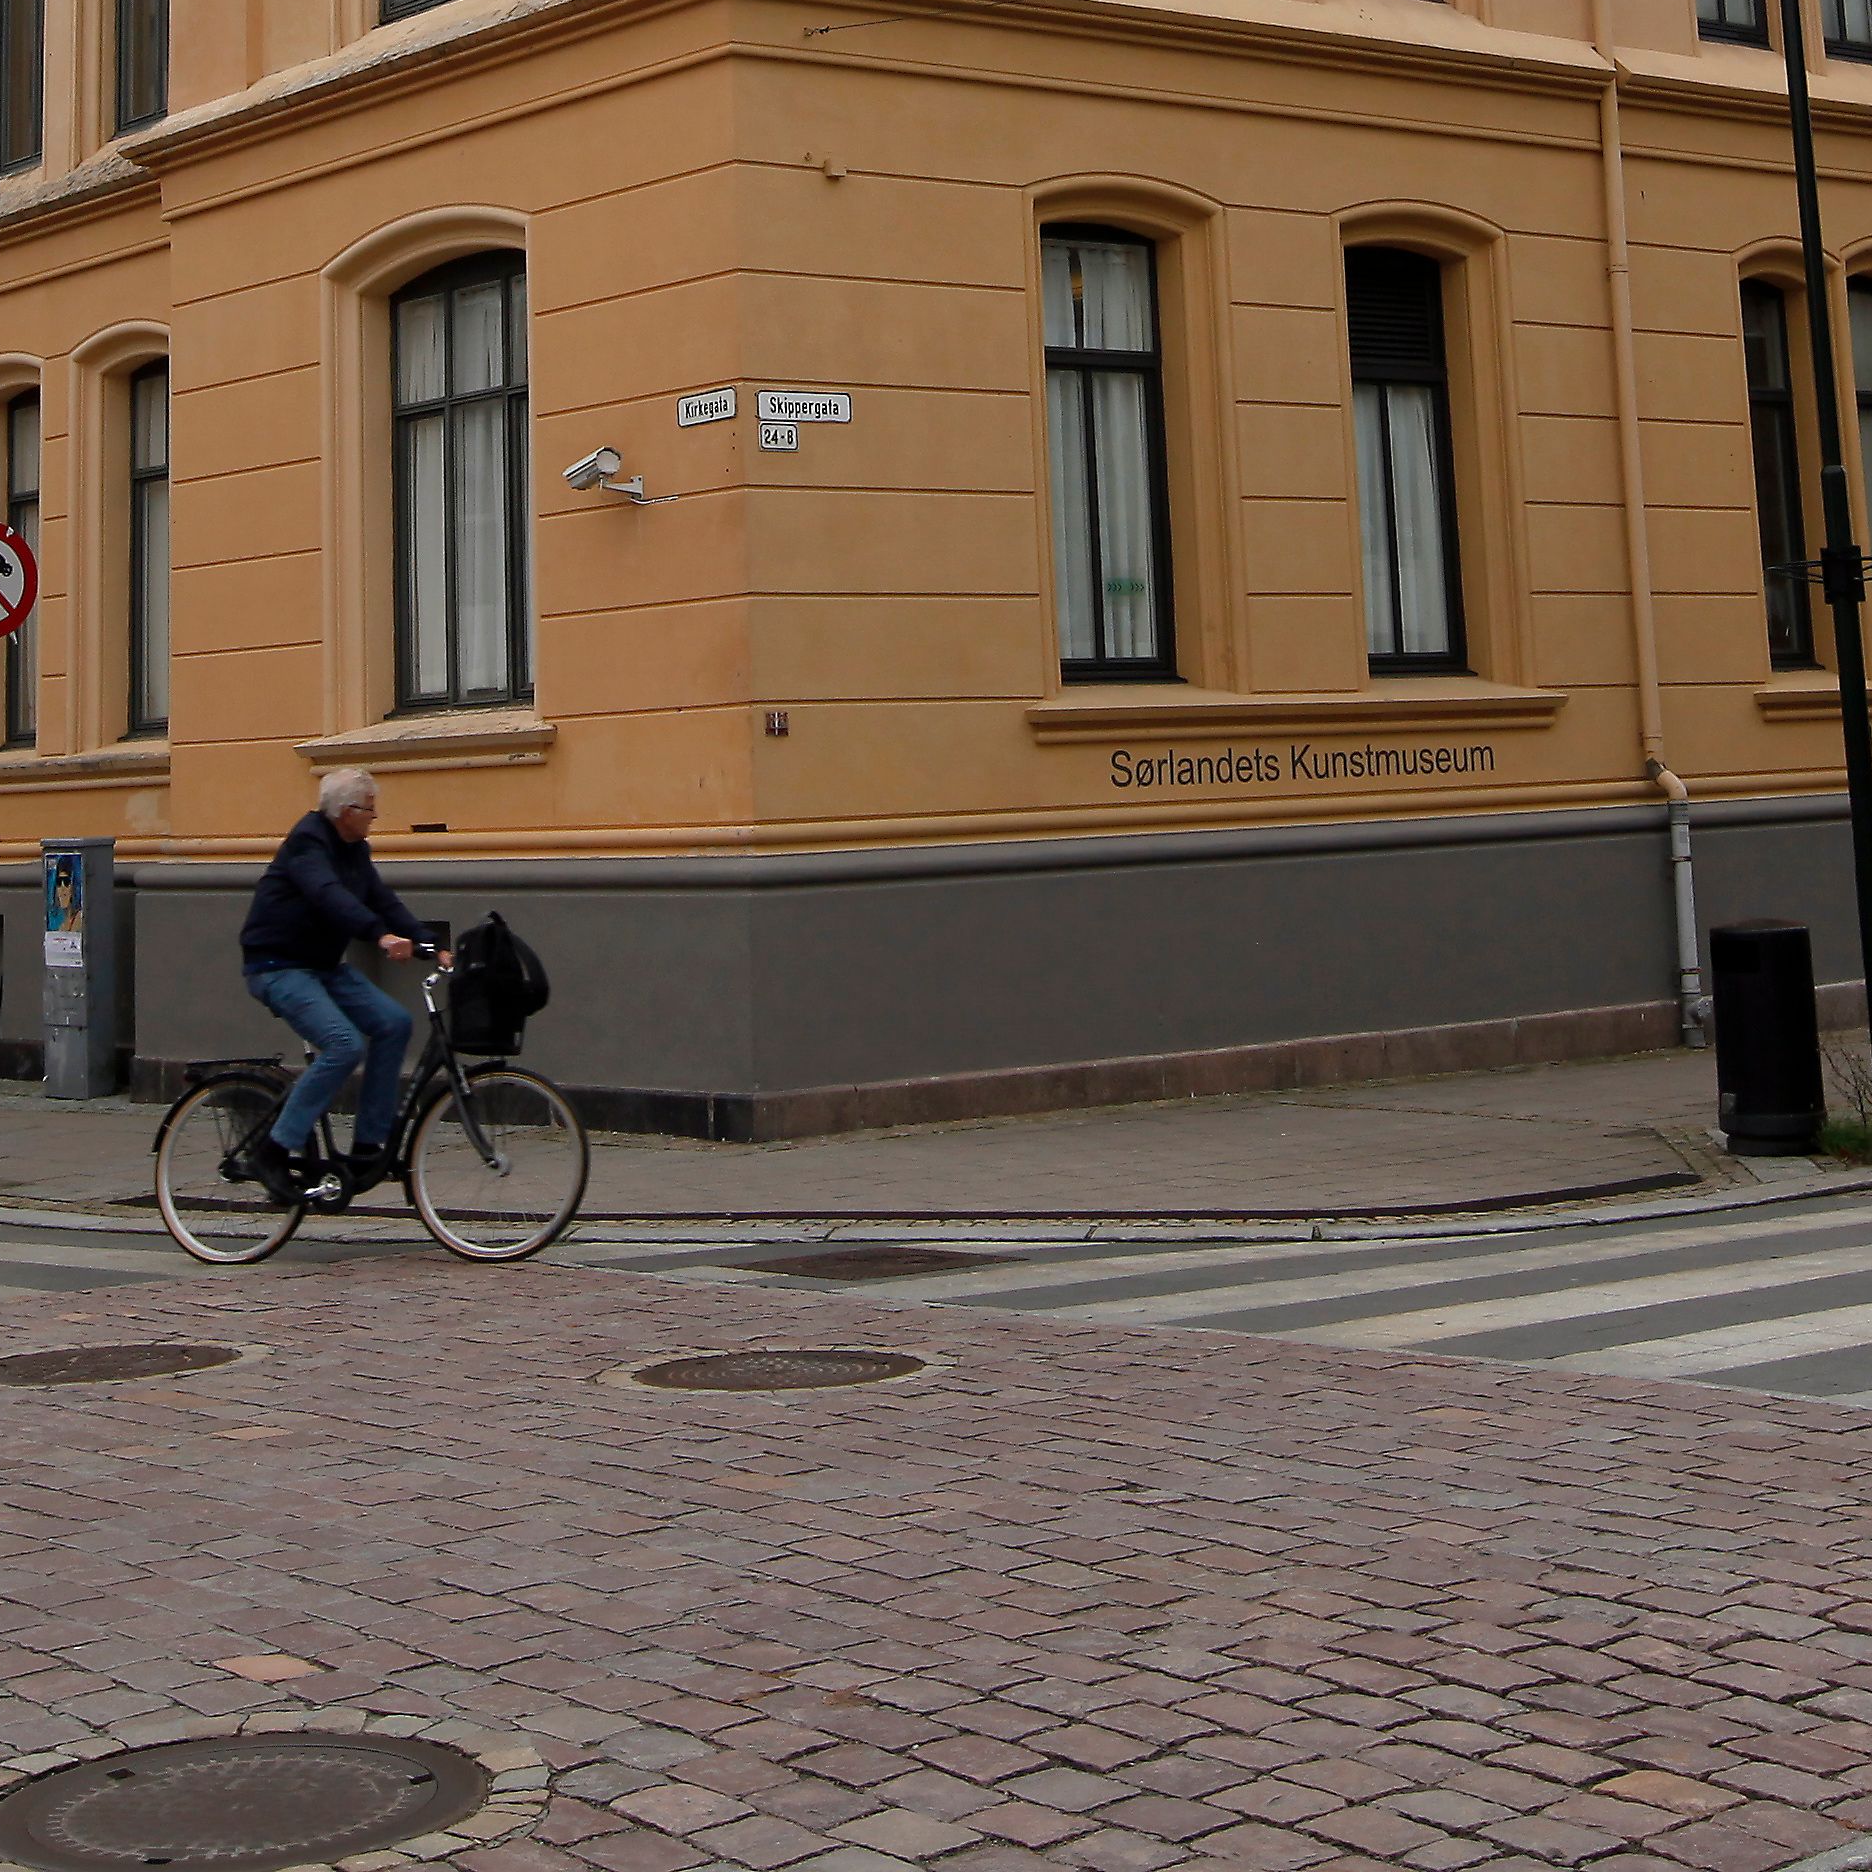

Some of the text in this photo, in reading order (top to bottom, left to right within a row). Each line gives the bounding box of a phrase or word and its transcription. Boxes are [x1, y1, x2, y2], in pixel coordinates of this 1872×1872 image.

[684, 395, 729, 419] Kirkegata
[769, 396, 840, 419] Skippergata
[1110, 743, 1496, 788] Sørlandets Kunstmuseum
